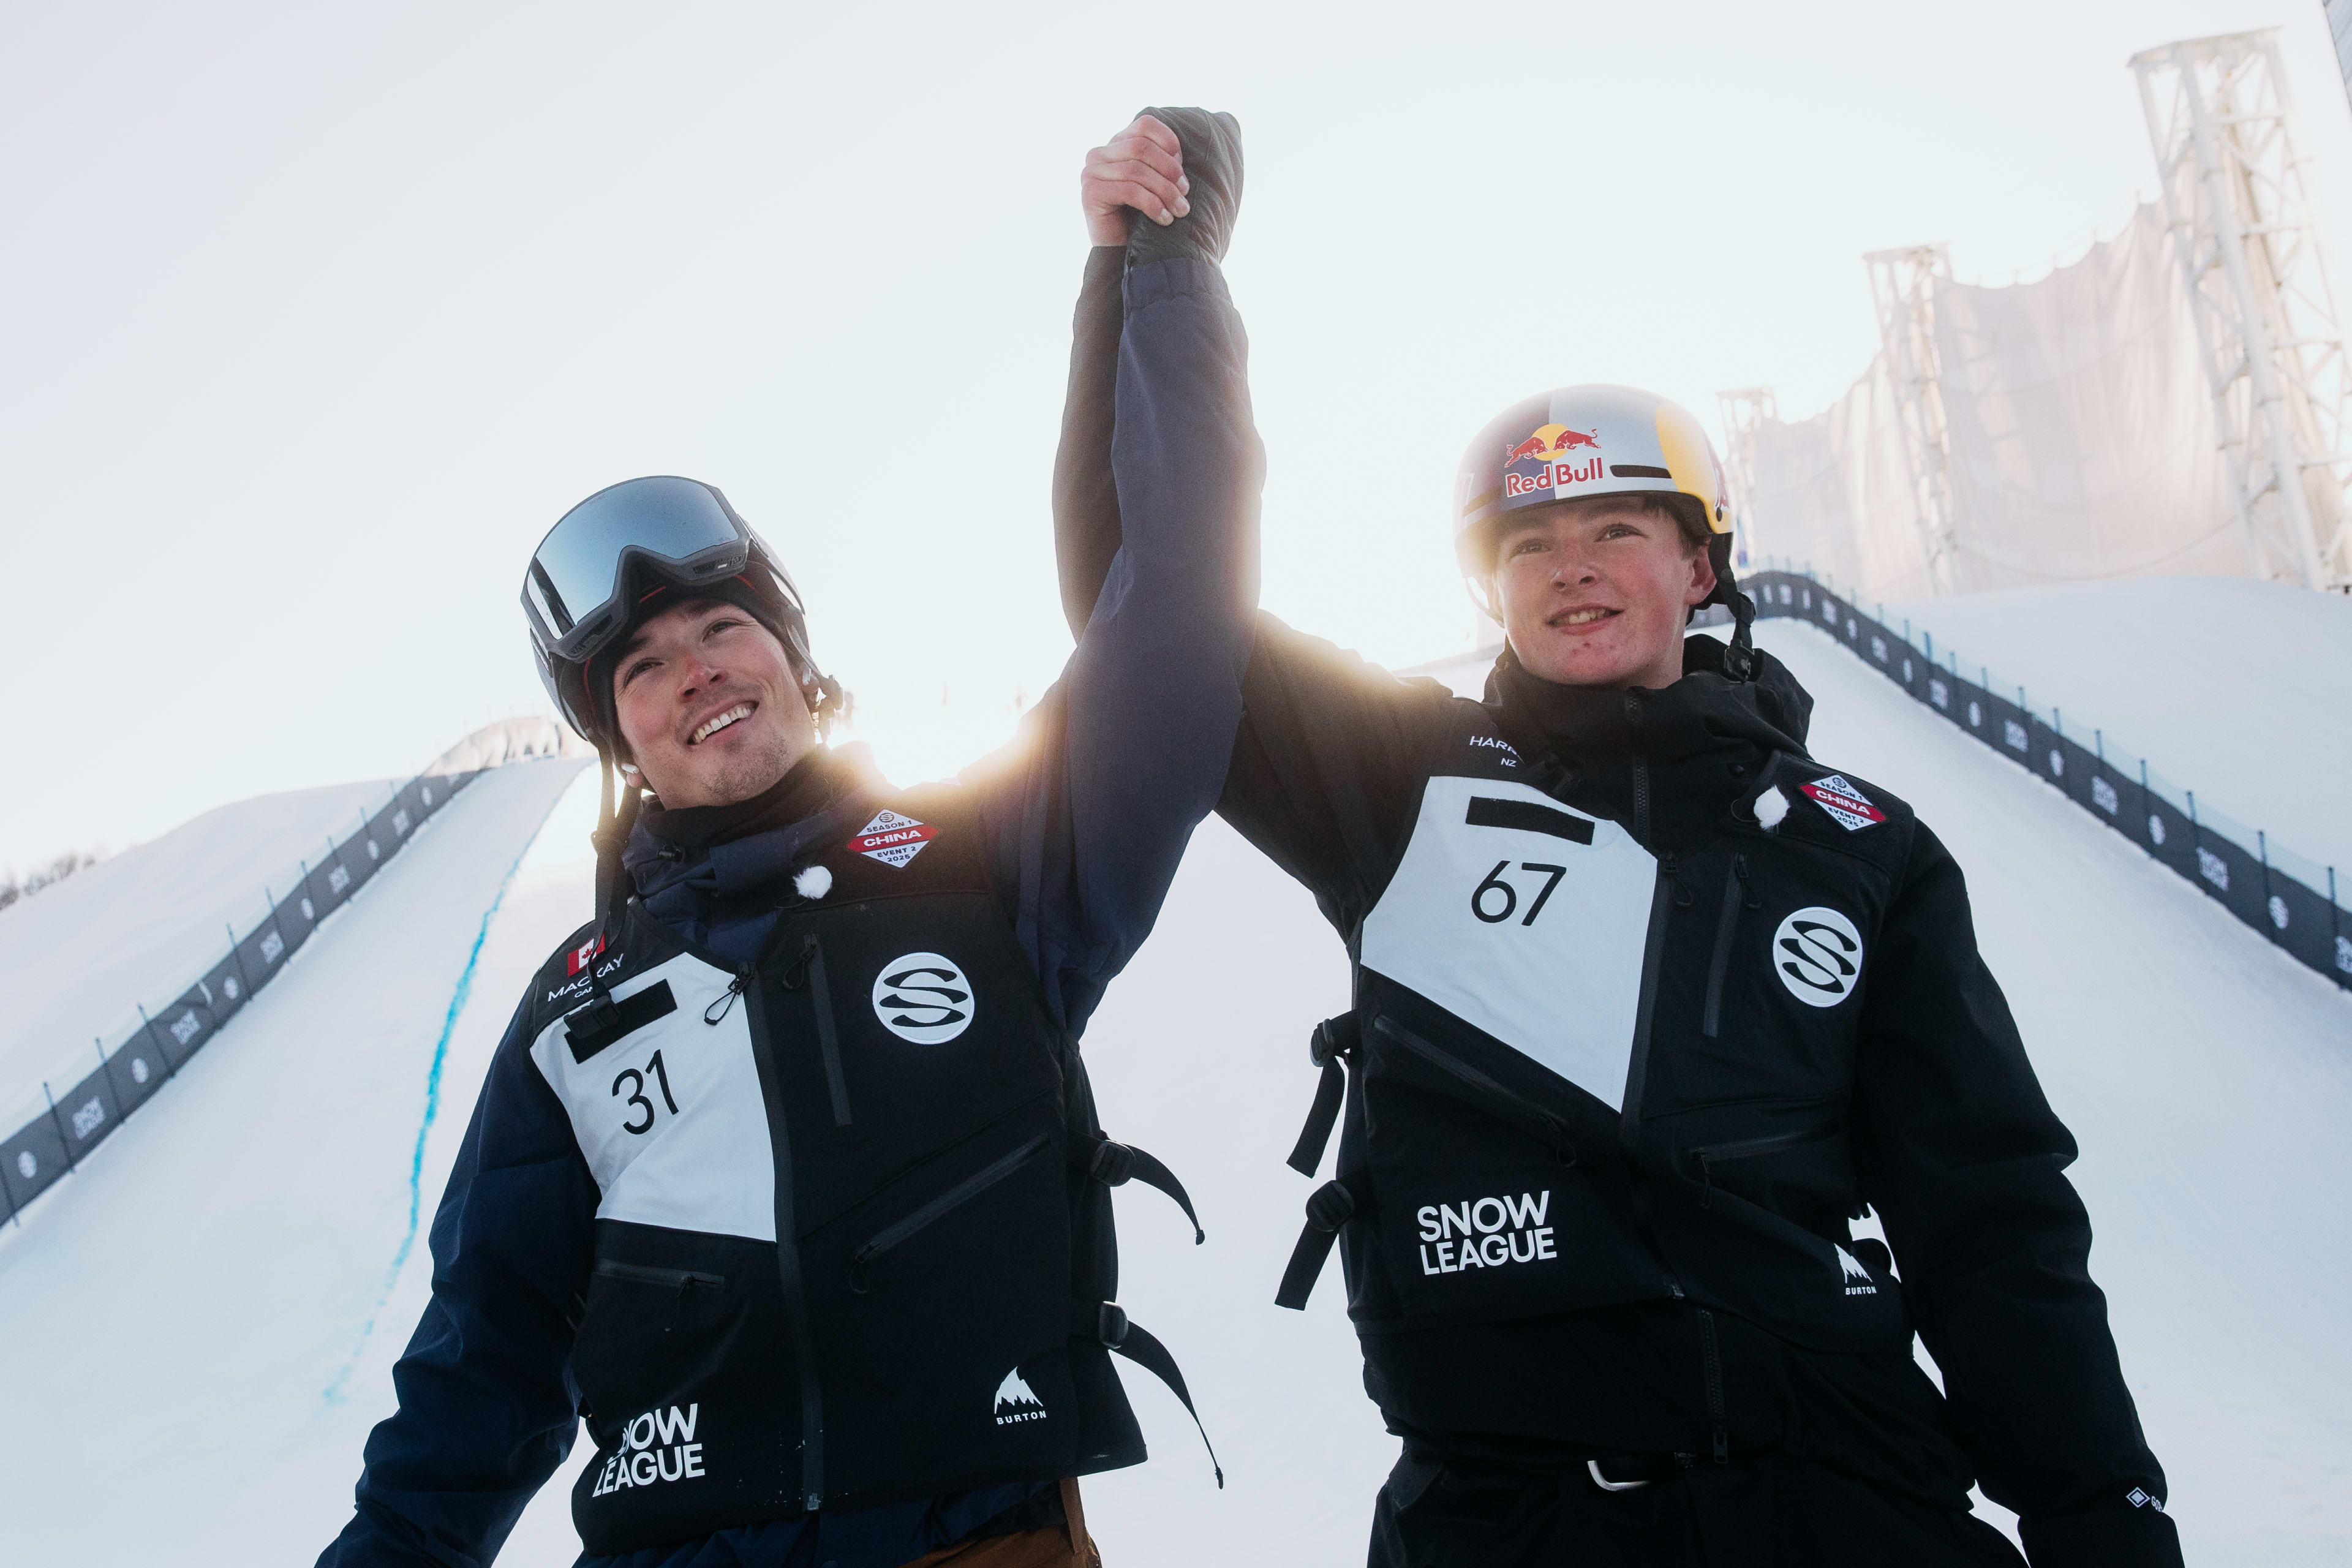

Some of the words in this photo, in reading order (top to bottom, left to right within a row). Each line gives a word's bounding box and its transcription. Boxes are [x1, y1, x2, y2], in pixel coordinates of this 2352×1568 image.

[1506, 465, 1552, 497] Red
[1555, 458, 1604, 485] Bull
[1501, 758, 1517, 767] NZ
[1820, 782, 1855, 798] SEASON
[1815, 790, 1871, 815] CHINA
[1828, 807, 1856, 820] EVENT
[1838, 816, 1859, 827] 2025
[867, 821, 905, 832] SEASON
[864, 830, 922, 846] CHINA
[877, 848, 907, 858] EVENT
[1471, 860, 1567, 926] 67
[612, 1049, 679, 1135] 31
[1417, 1190, 1550, 1242] SNOW
[1420, 1227, 1557, 1275] LEAGUE
[1845, 1286, 1877, 1295] BURTON
[996, 1411, 1047, 1425] BURTON
[592, 1443, 706, 1498] LEAGUE
